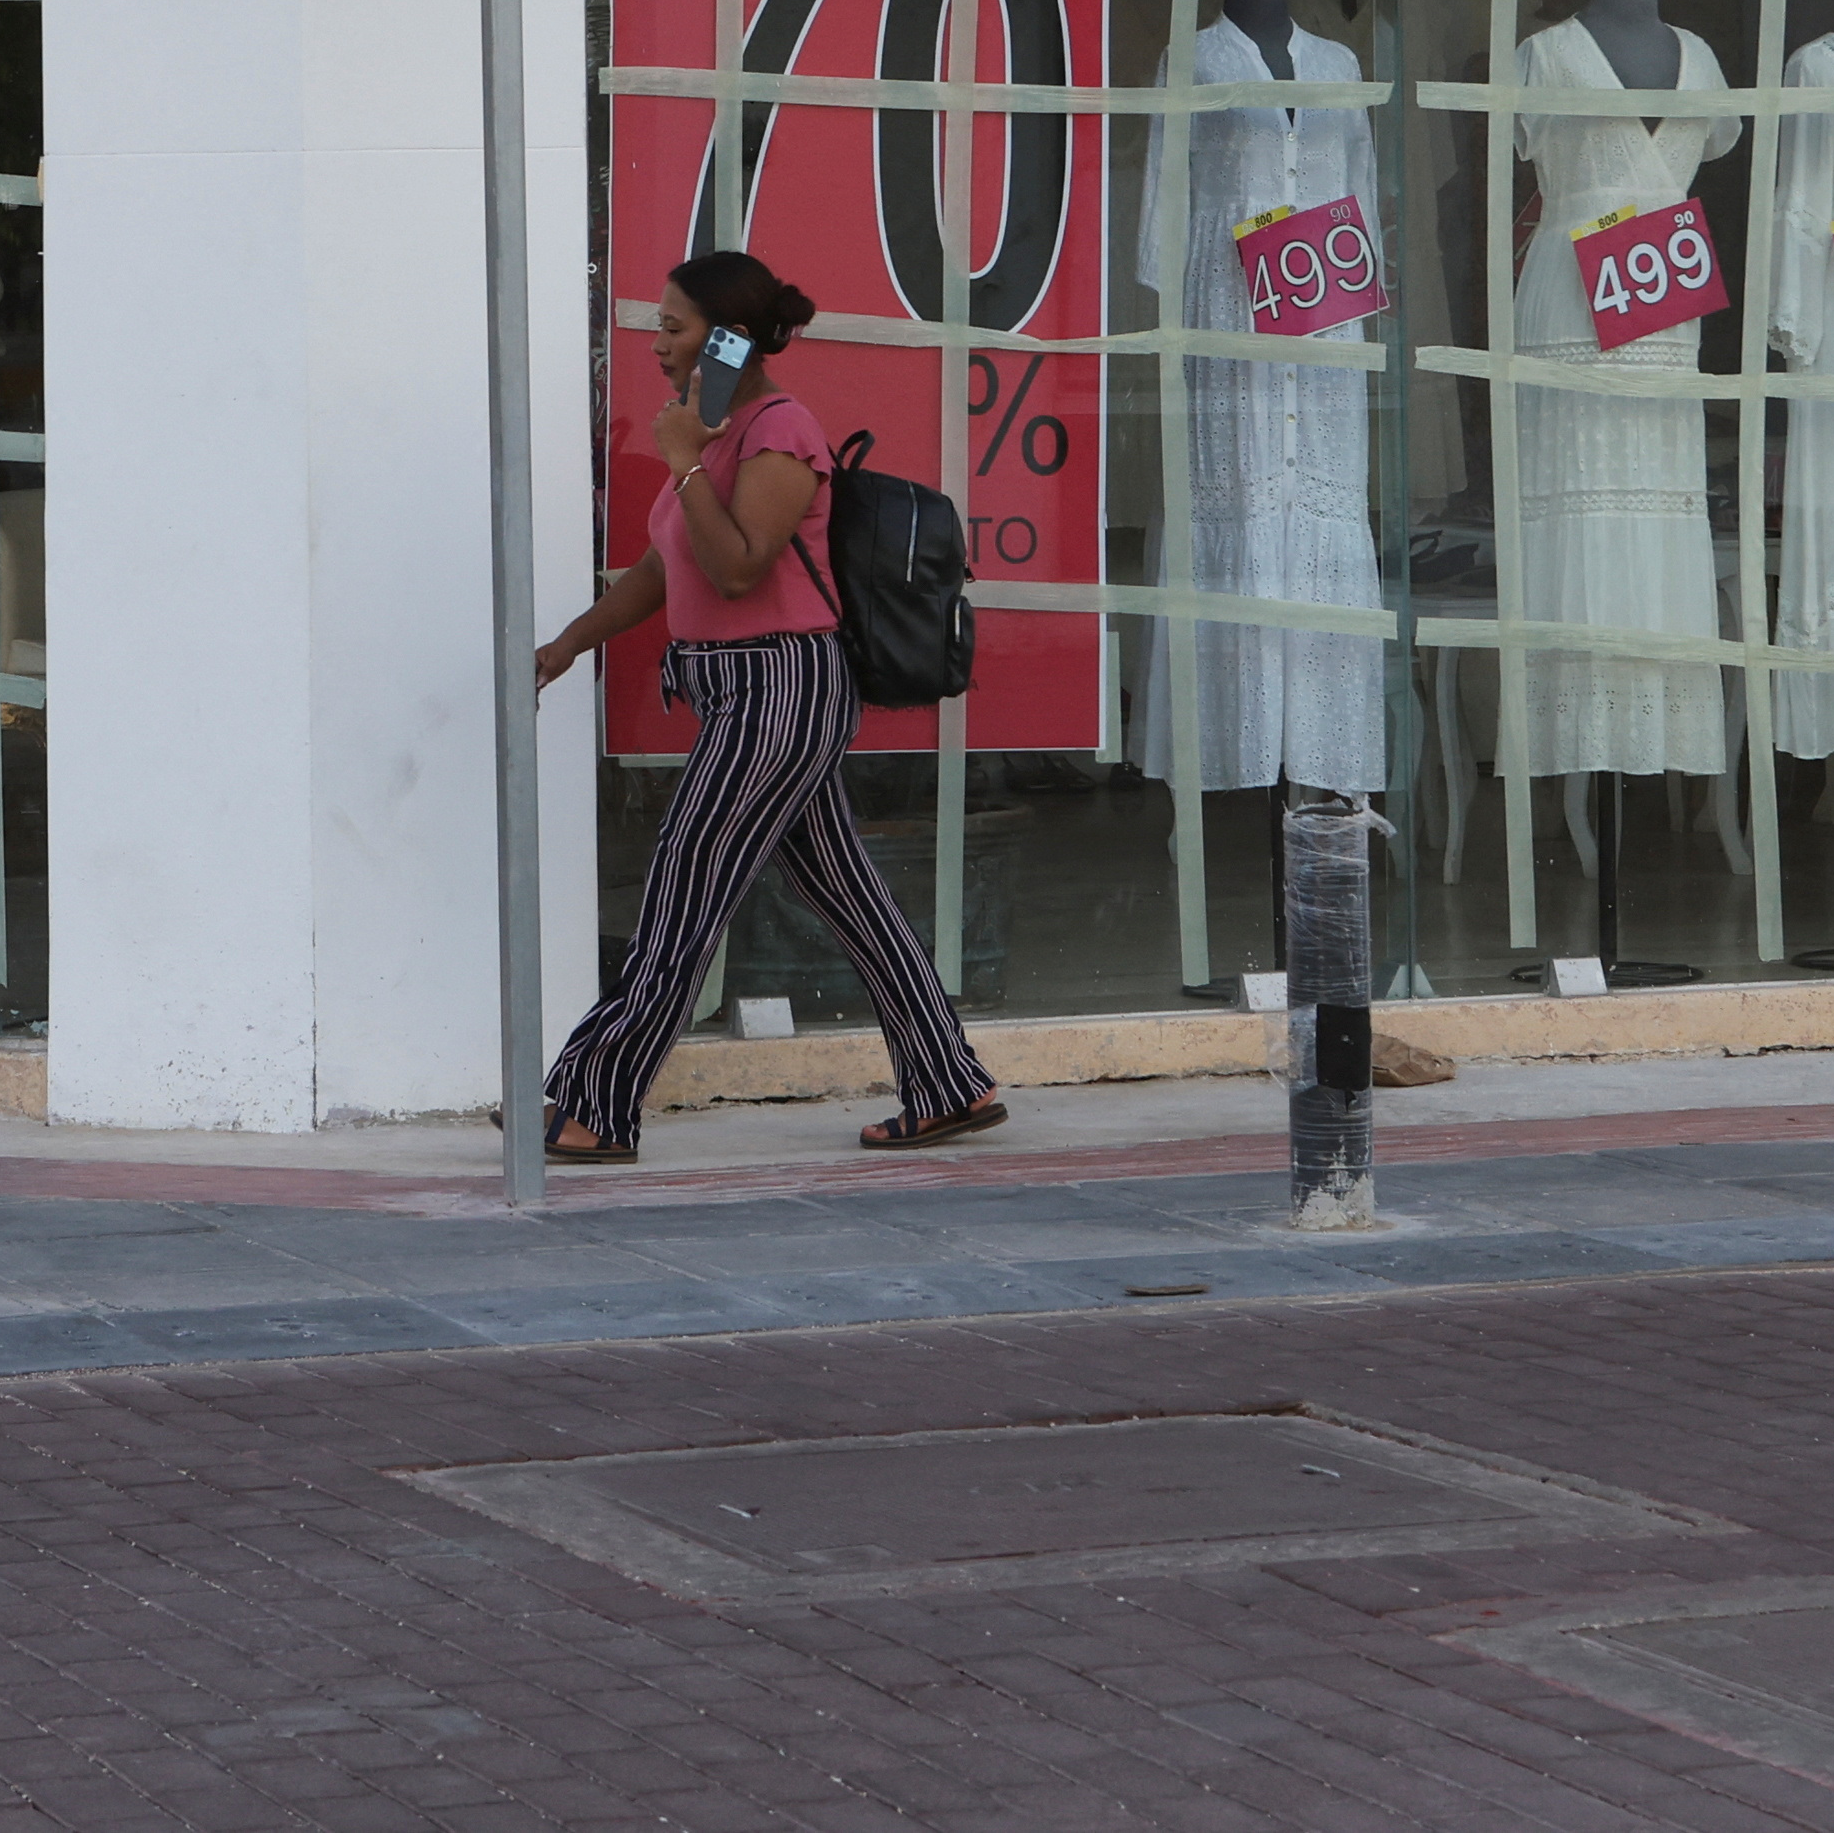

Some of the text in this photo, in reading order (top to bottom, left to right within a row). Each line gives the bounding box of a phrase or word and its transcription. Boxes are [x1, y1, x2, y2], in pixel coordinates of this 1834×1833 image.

[1254, 212, 1274, 229] 800
[1330, 204, 1351, 222] 90
[1597, 212, 1618, 229] 800
[1674, 210, 1695, 228] 90
[1252, 223, 1377, 321] 499
[1593, 228, 1713, 315] 499
